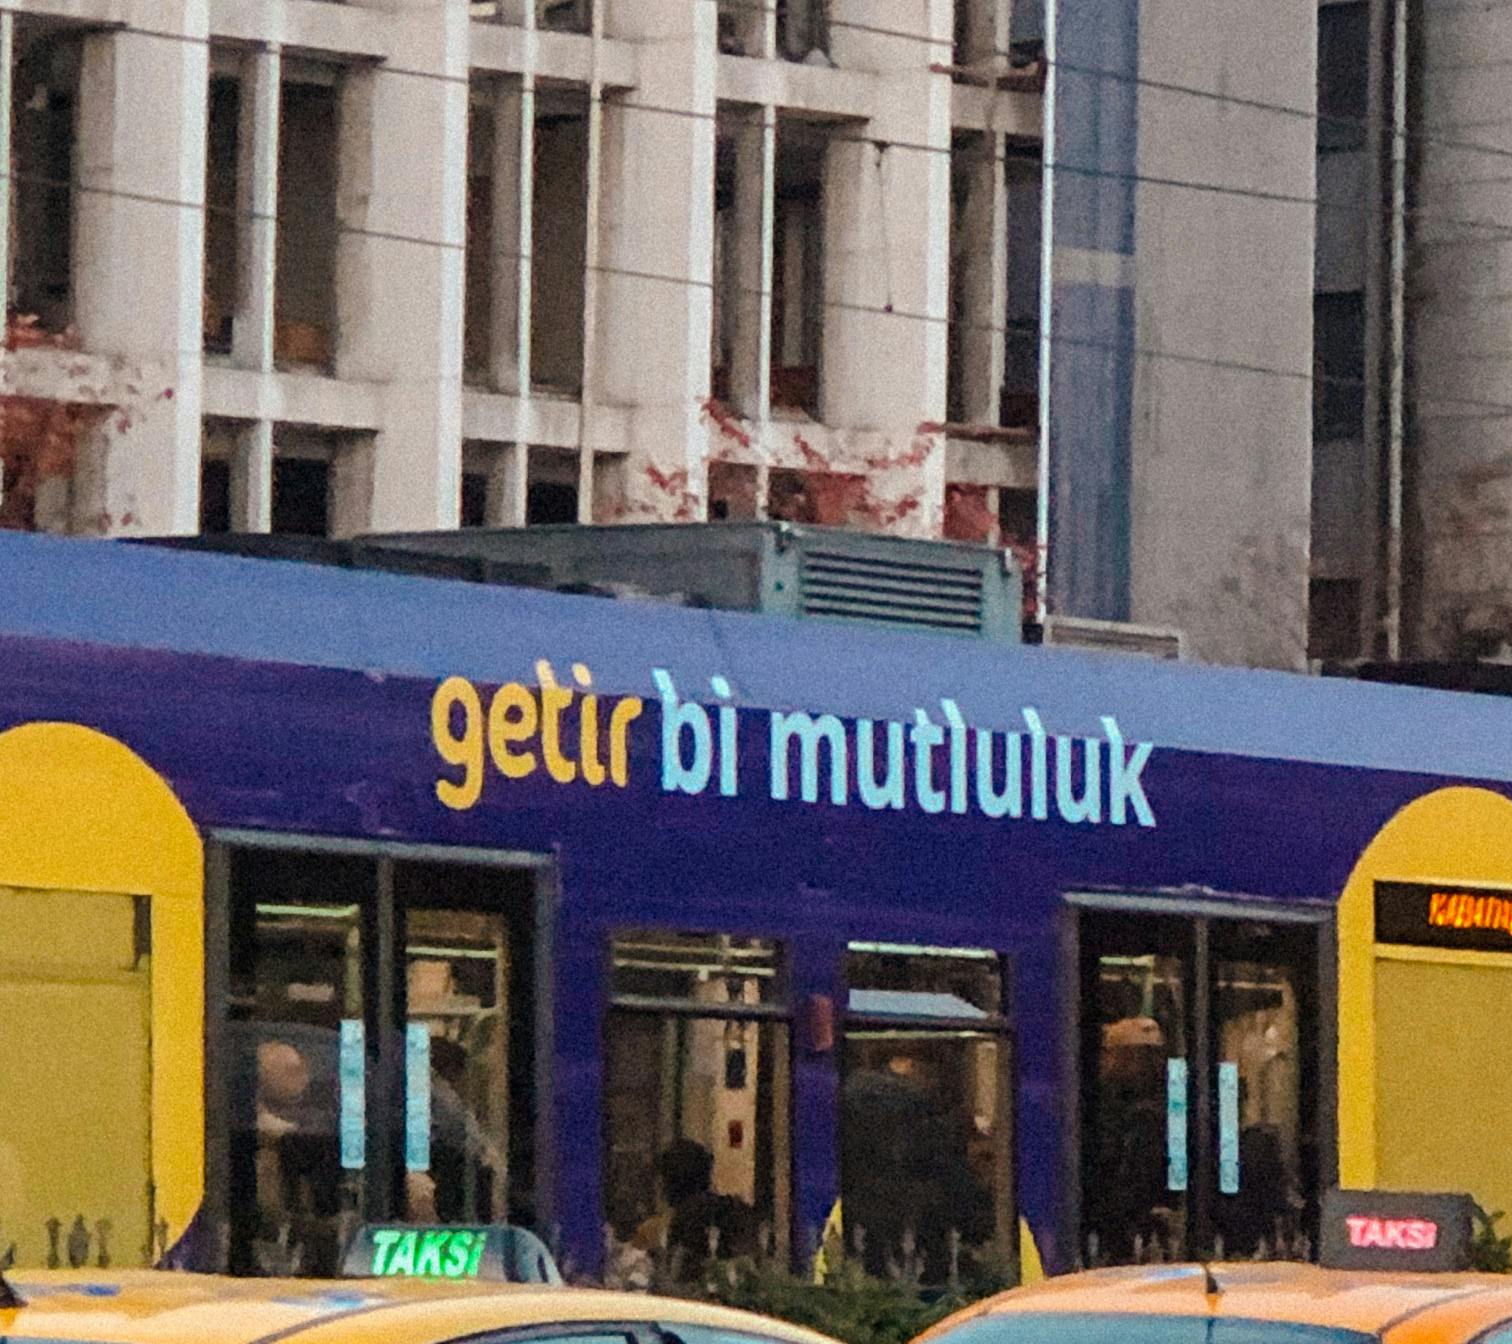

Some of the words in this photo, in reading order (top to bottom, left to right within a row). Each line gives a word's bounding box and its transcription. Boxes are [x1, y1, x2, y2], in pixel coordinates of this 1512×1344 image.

[431, 659, 642, 809] getir
[652, 667, 739, 797] bi
[770, 699, 1156, 827] mutluluk
